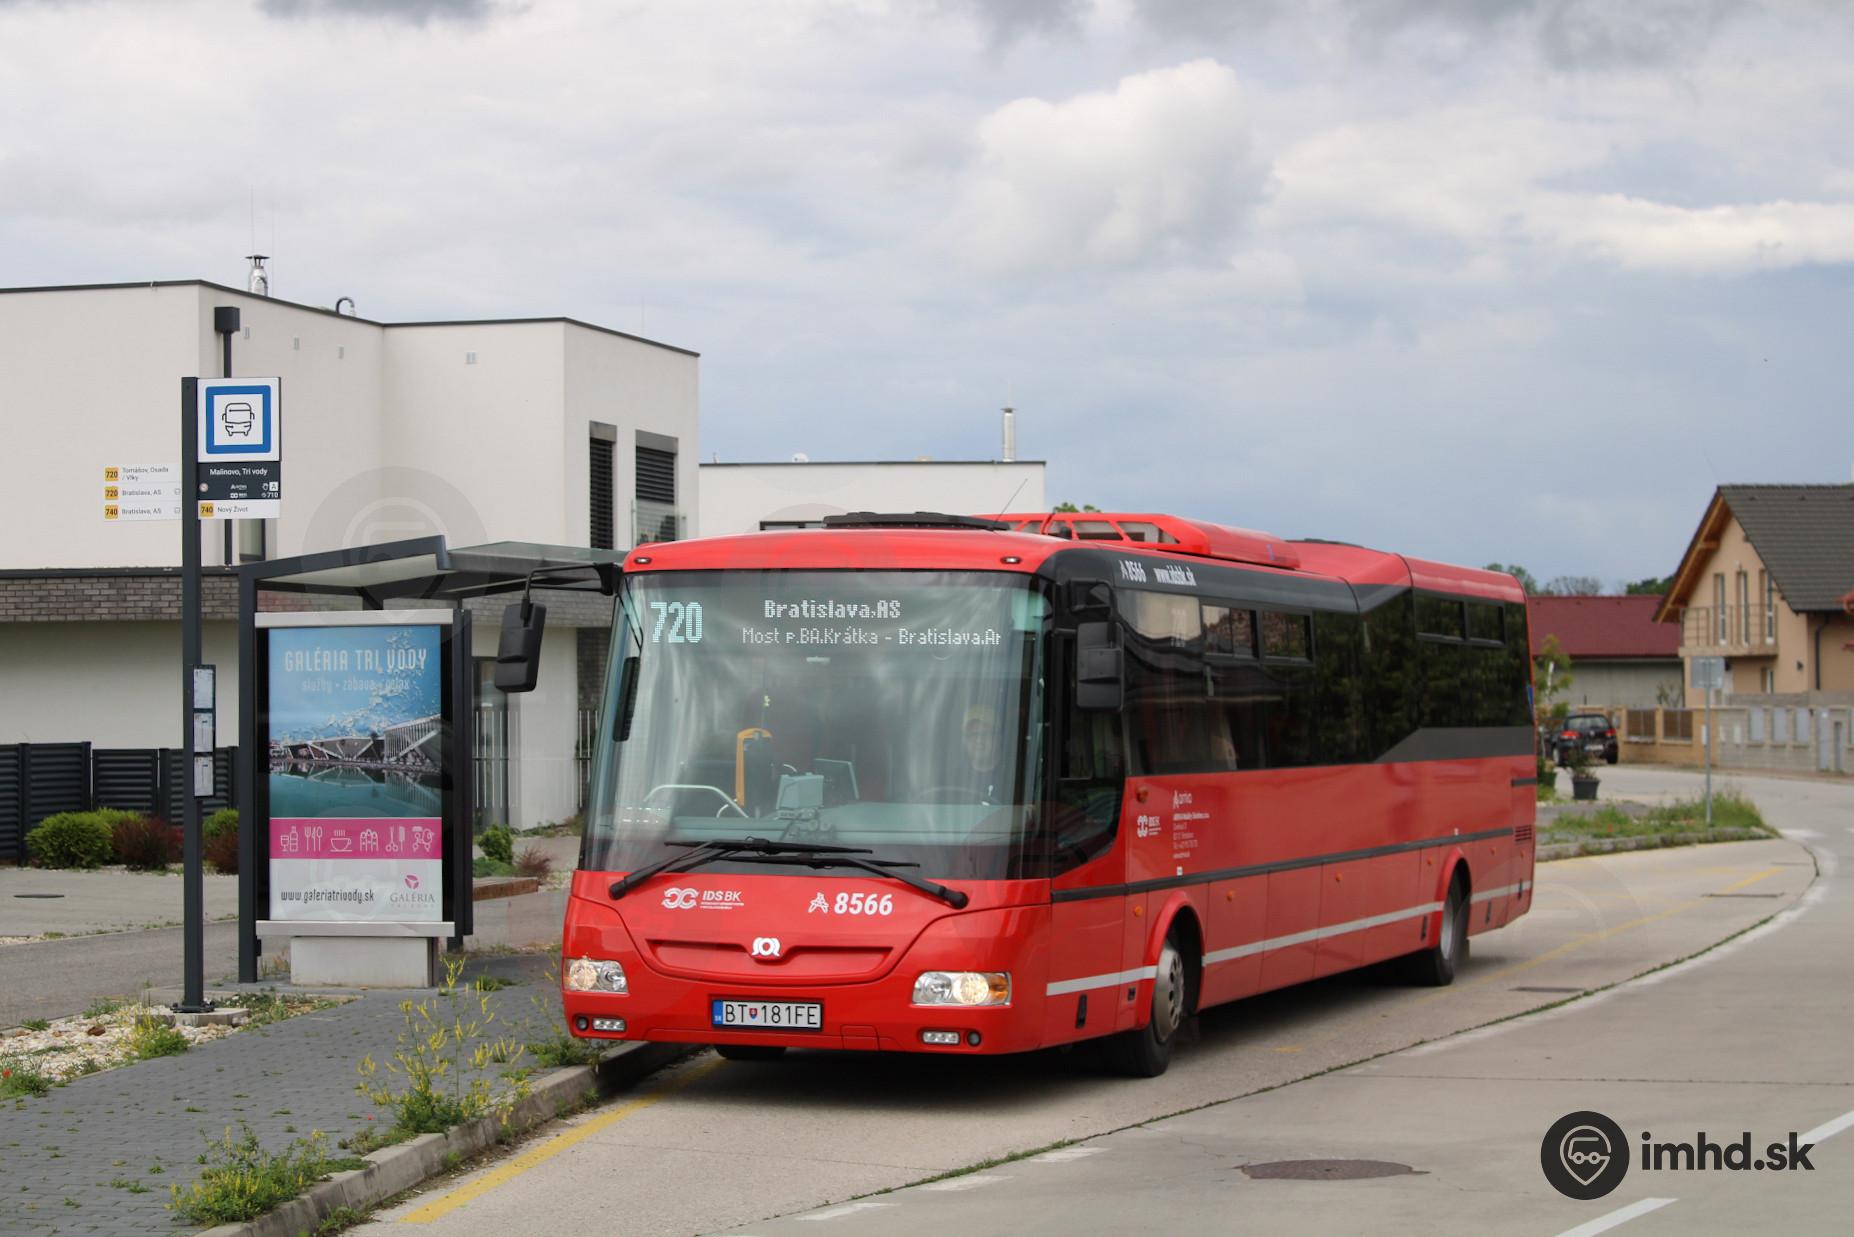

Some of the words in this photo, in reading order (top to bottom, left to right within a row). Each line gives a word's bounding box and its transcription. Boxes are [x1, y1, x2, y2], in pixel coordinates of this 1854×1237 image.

[209, 468, 241, 476] Malinovo,
[242, 467, 251, 475] Tri
[252, 468, 268, 476] vody
[650, 601, 703, 643] 720
[742, 627, 780, 644] Most
[284, 646, 349, 672] GALÉRIA
[355, 649, 379, 672] TRI
[386, 648, 427, 671] VODY
[281, 888, 374, 904] www.galeriatrivody.sk
[702, 890, 723, 901] IDS
[724, 891, 742, 902] BK
[834, 892, 894, 916] 8566
[725, 1004, 748, 1023] BT
[761, 1005, 818, 1025] 181FE
